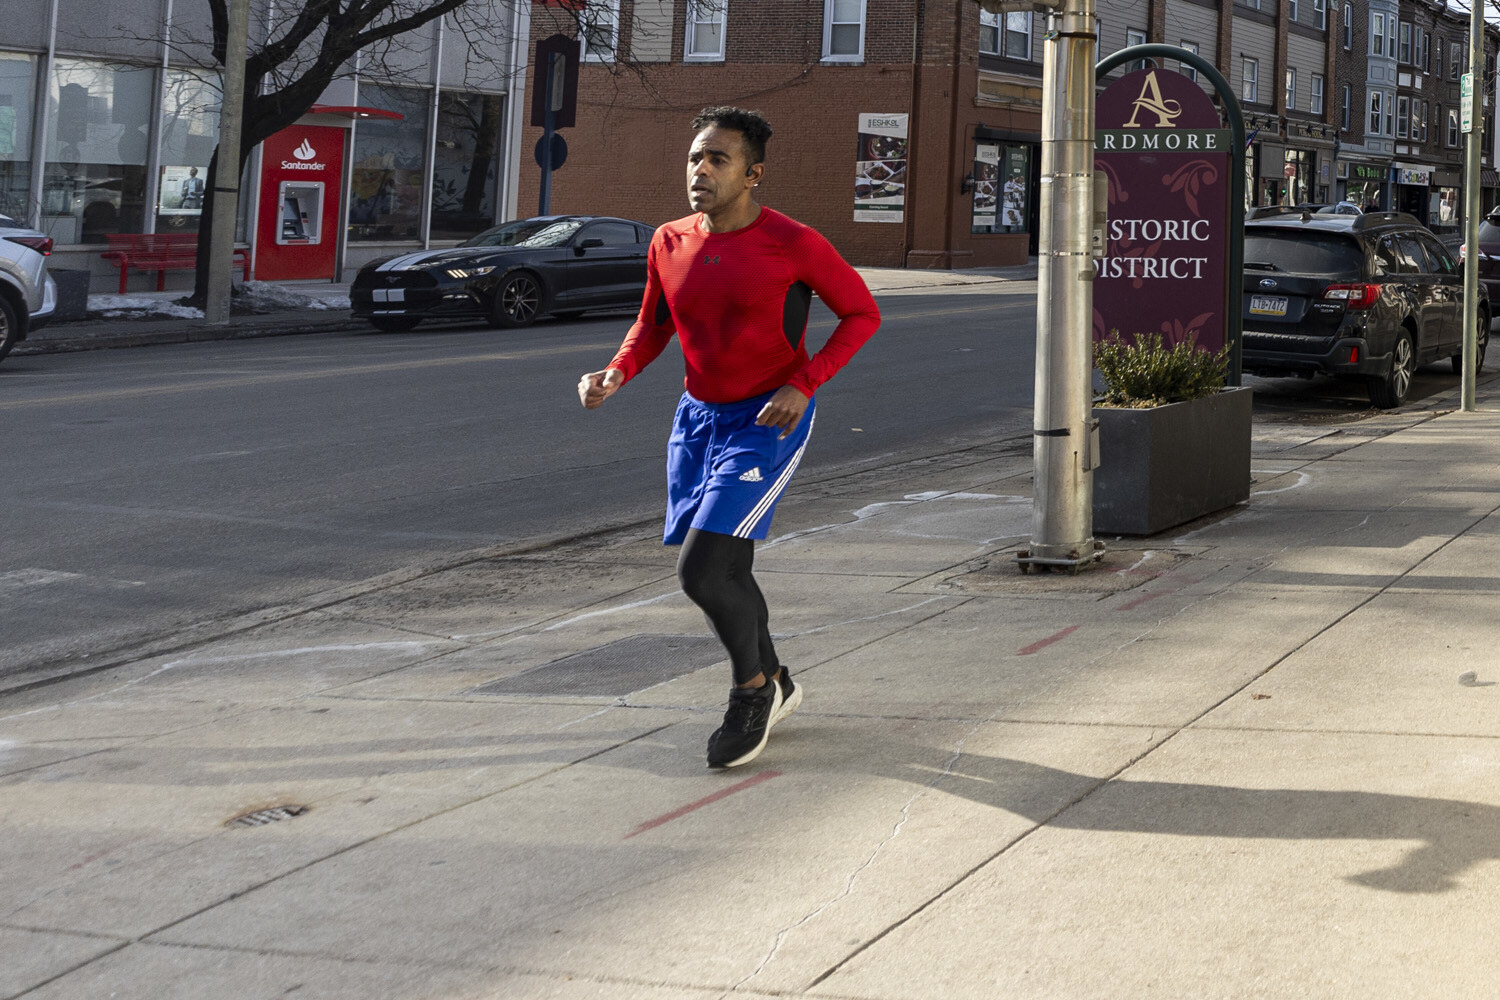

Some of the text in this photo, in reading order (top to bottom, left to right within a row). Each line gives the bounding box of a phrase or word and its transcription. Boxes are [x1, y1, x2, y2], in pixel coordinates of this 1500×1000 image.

[872, 118, 900, 127] ESHKOL
[1094, 133, 1217, 150] RDMORE
[281, 160, 326, 171] Santander
[1107, 218, 1210, 241] STORIC
